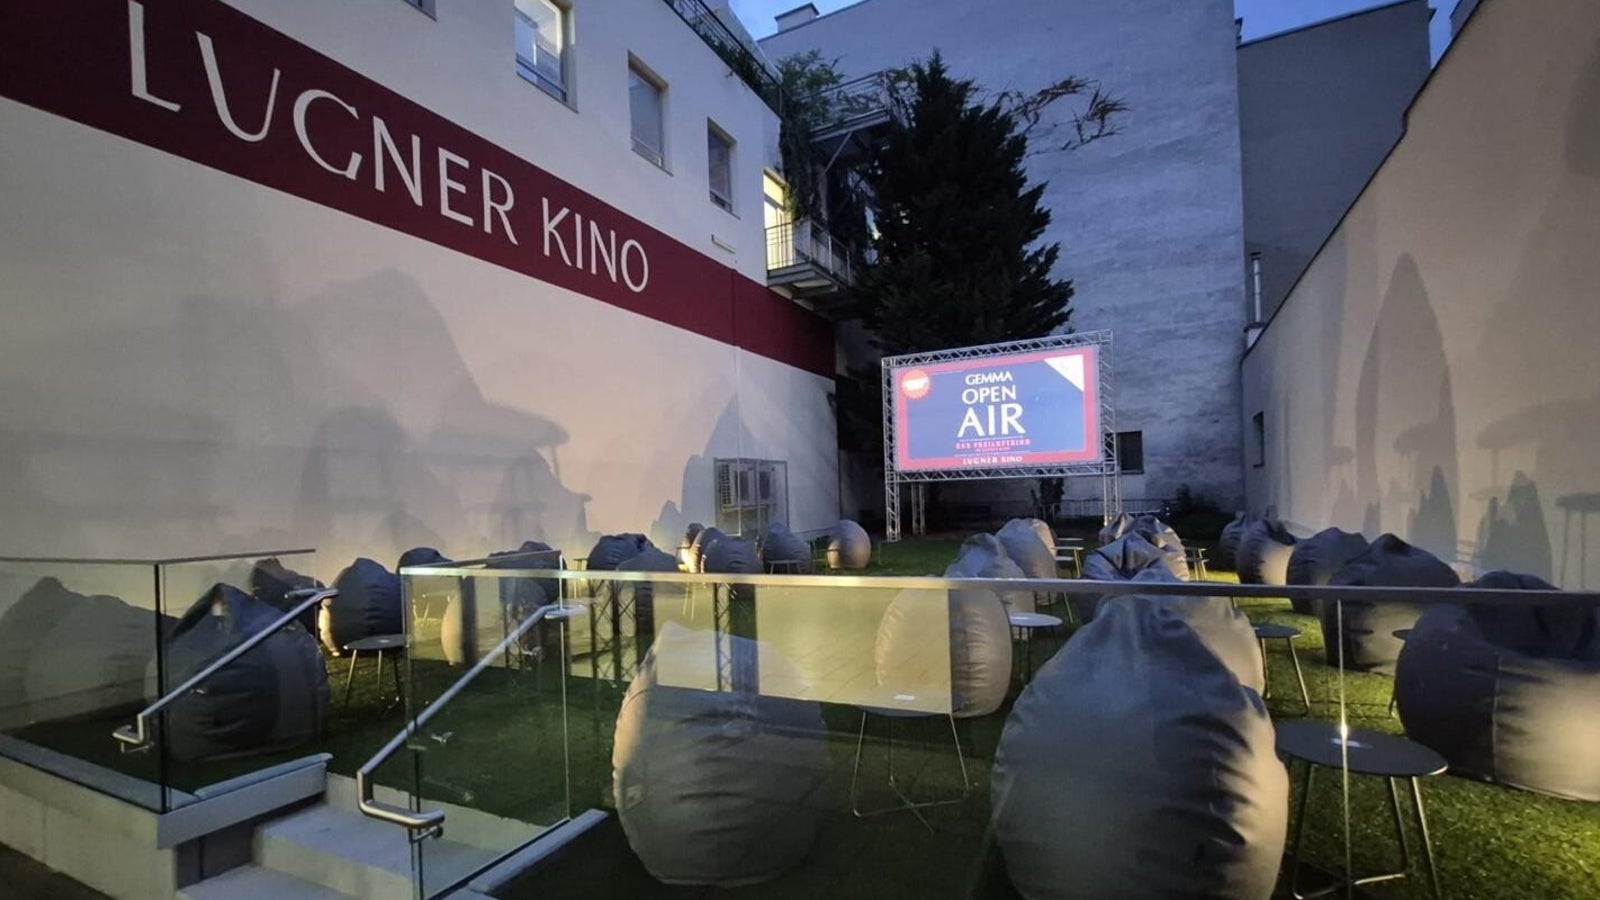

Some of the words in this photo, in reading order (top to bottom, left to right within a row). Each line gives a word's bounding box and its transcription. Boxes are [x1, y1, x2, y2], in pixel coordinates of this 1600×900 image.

[127, 0, 518, 245] LUGNER
[542, 197, 649, 293] KINO
[965, 371, 1013, 385] GEMMA
[962, 385, 1016, 404] OPEN
[957, 403, 1026, 438] AIR
[963, 456, 998, 466] LUGNER
[1001, 455, 1023, 463] KINO
